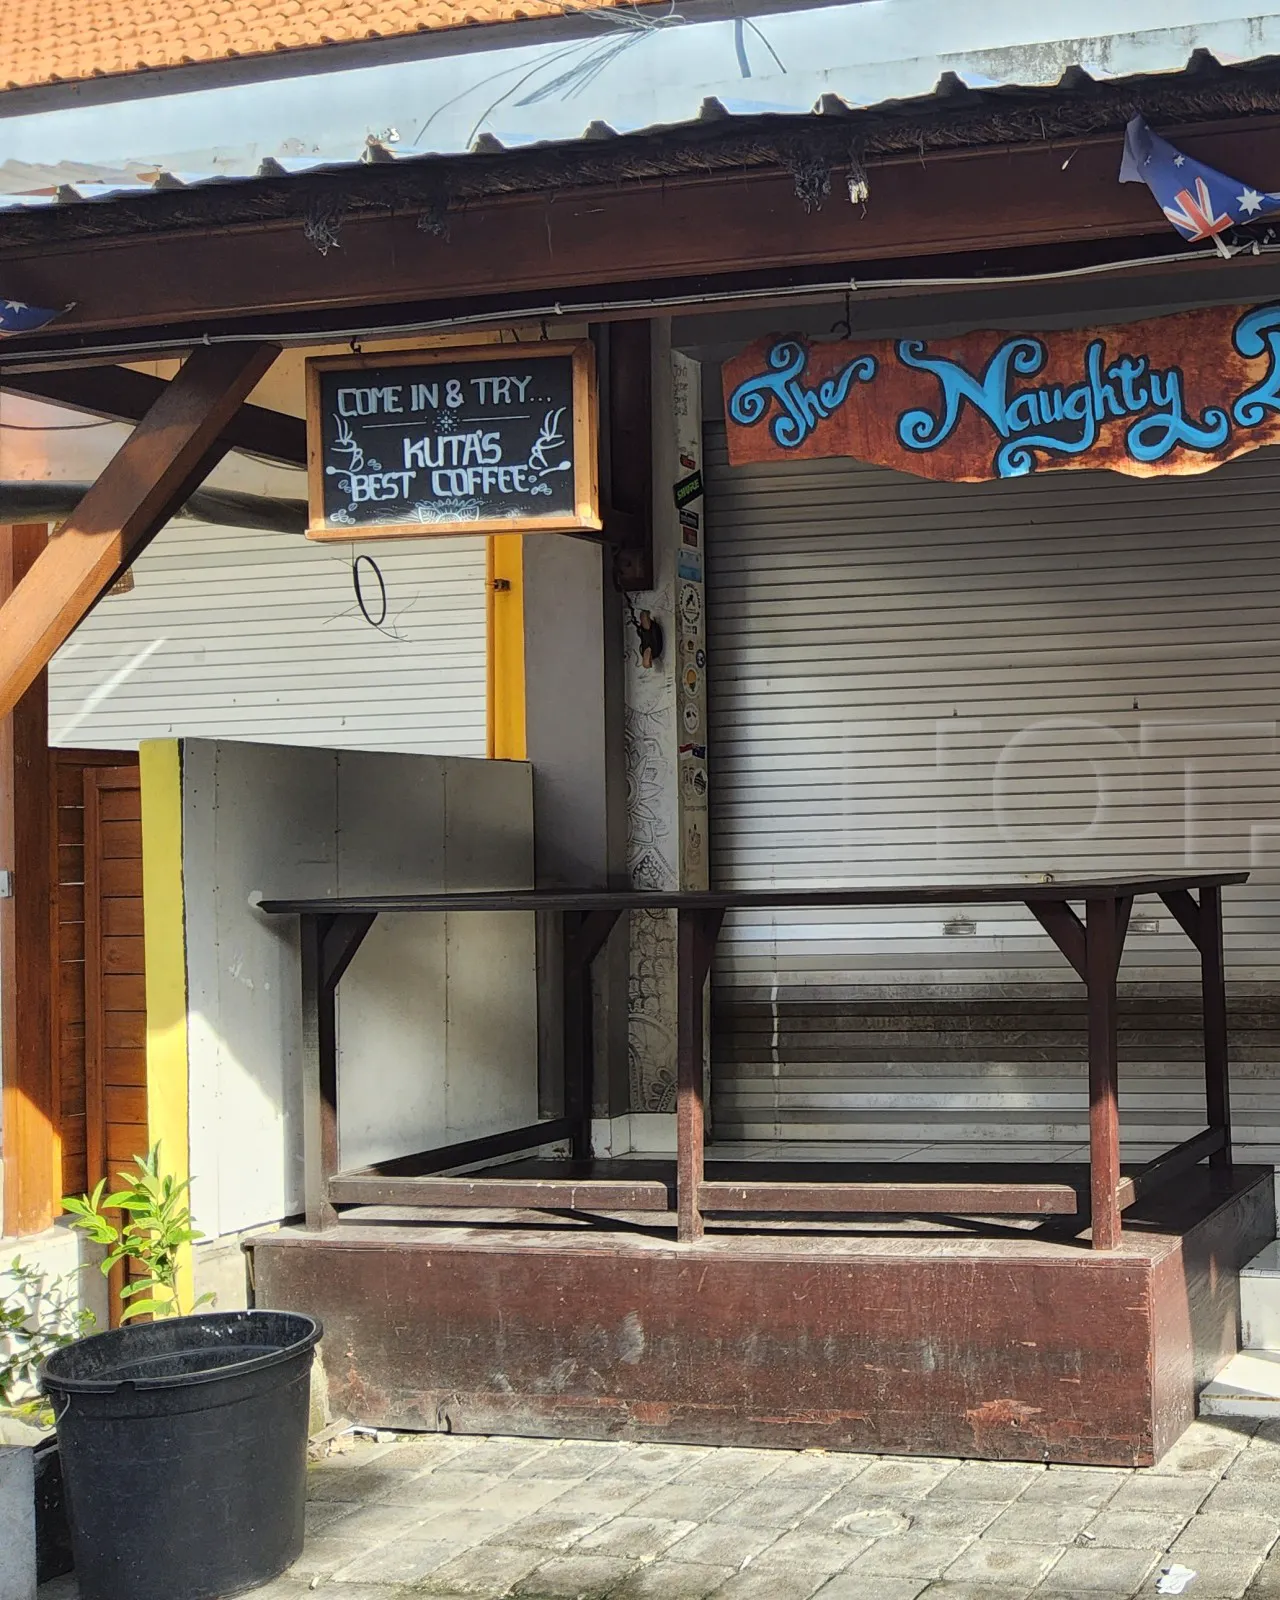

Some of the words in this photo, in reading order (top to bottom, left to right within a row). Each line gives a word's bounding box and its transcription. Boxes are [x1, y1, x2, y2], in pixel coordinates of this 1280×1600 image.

[337, 385, 403, 417] COME
[411, 382, 439, 411] IN
[445, 379, 465, 408] &
[731, 338, 876, 448] The
[899, 336, 1229, 478] Naughty
[403, 430, 502, 469] KUTA'S
[351, 471, 416, 502] BEST
[432, 464, 530, 498] COFFEE
